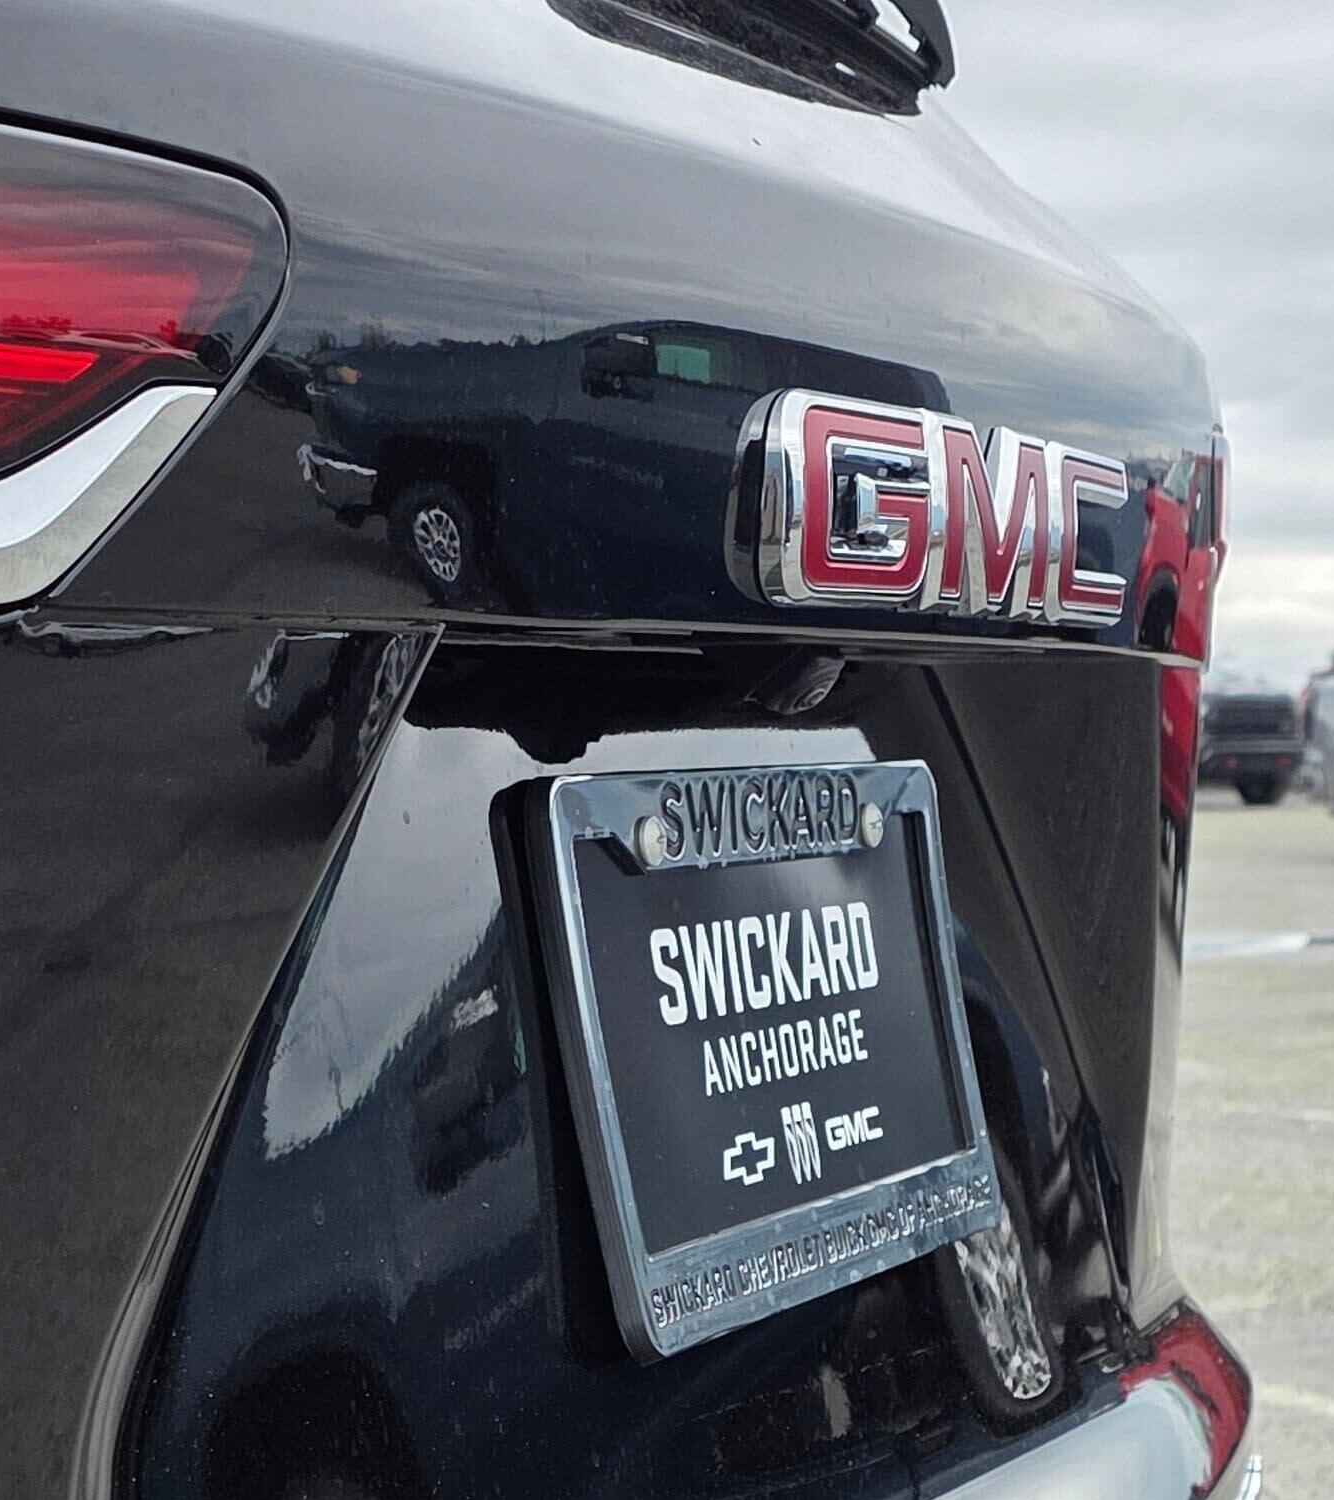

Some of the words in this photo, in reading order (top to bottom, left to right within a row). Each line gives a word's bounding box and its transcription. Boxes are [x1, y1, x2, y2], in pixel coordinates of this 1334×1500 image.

[757, 387, 1130, 629] GMC
[660, 772, 860, 862] SWICKARD
[650, 901, 879, 1026] SWICKARD
[703, 1009, 869, 1097] ANCHORAGE
[824, 1105, 884, 1151] GMC
[651, 1263, 736, 1329] SWICKARD
[736, 1232, 825, 1297] CHEVROLET
[824, 1211, 870, 1265] BUICK
